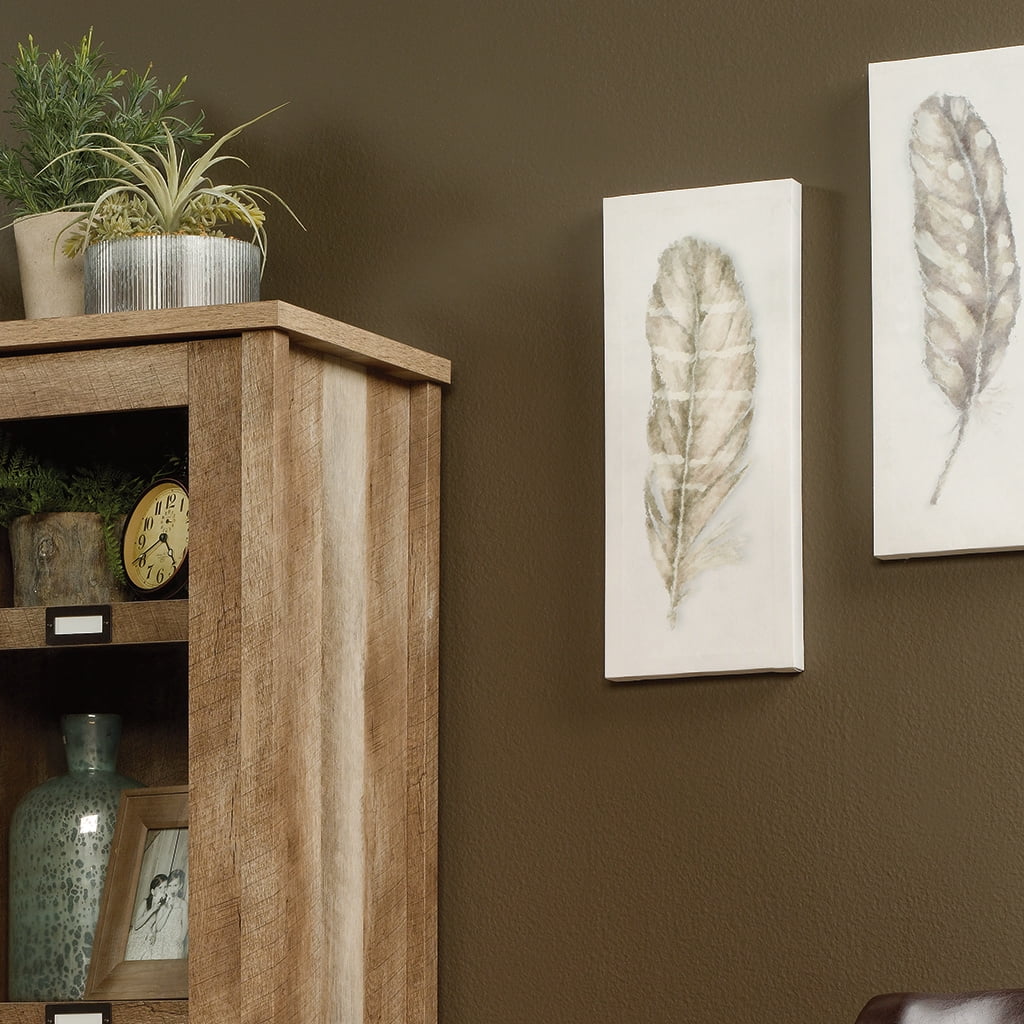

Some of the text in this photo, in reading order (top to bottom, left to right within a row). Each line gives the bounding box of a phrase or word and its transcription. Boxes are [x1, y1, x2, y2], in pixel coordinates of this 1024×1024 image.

[154, 501, 162, 515] 11
[165, 494, 177, 509] 12
[179, 498, 185, 512] 1
[143, 517, 154, 532] 10
[137, 534, 146, 549] 9
[146, 564, 154, 579] 7
[156, 568, 164, 584] 6
